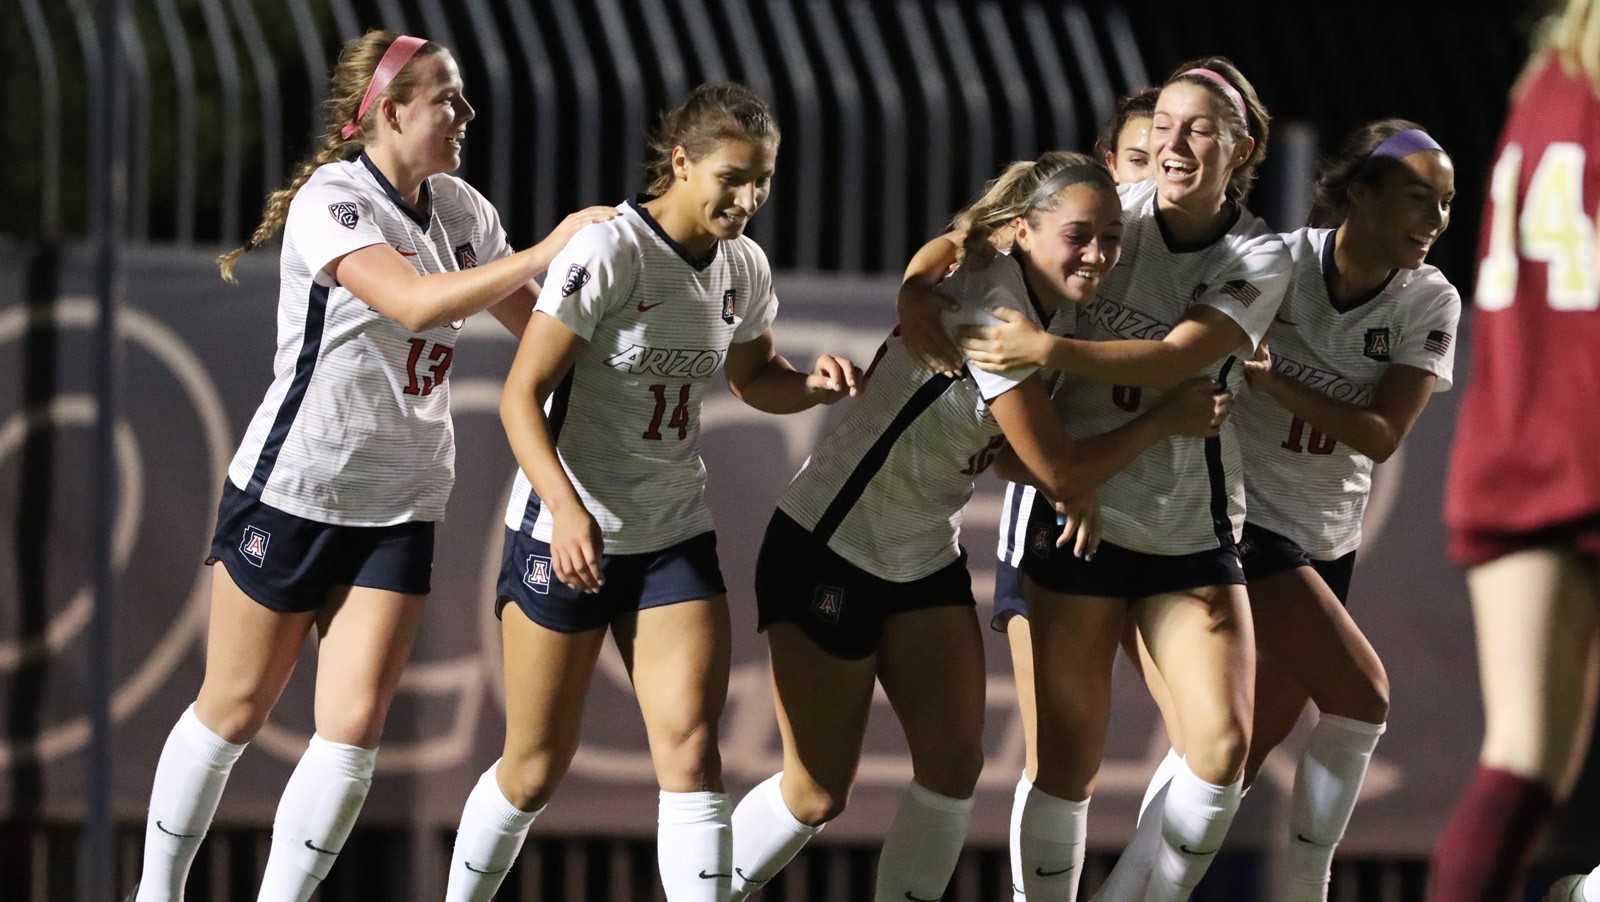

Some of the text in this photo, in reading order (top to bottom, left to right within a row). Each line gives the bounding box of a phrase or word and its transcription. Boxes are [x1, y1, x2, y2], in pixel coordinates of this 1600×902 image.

[1476, 141, 1599, 312] 14
[403, 337, 453, 396] 13
[603, 344, 727, 378] ARIZO
[1269, 351, 1376, 407] RIZO
[641, 383, 691, 441] 14
